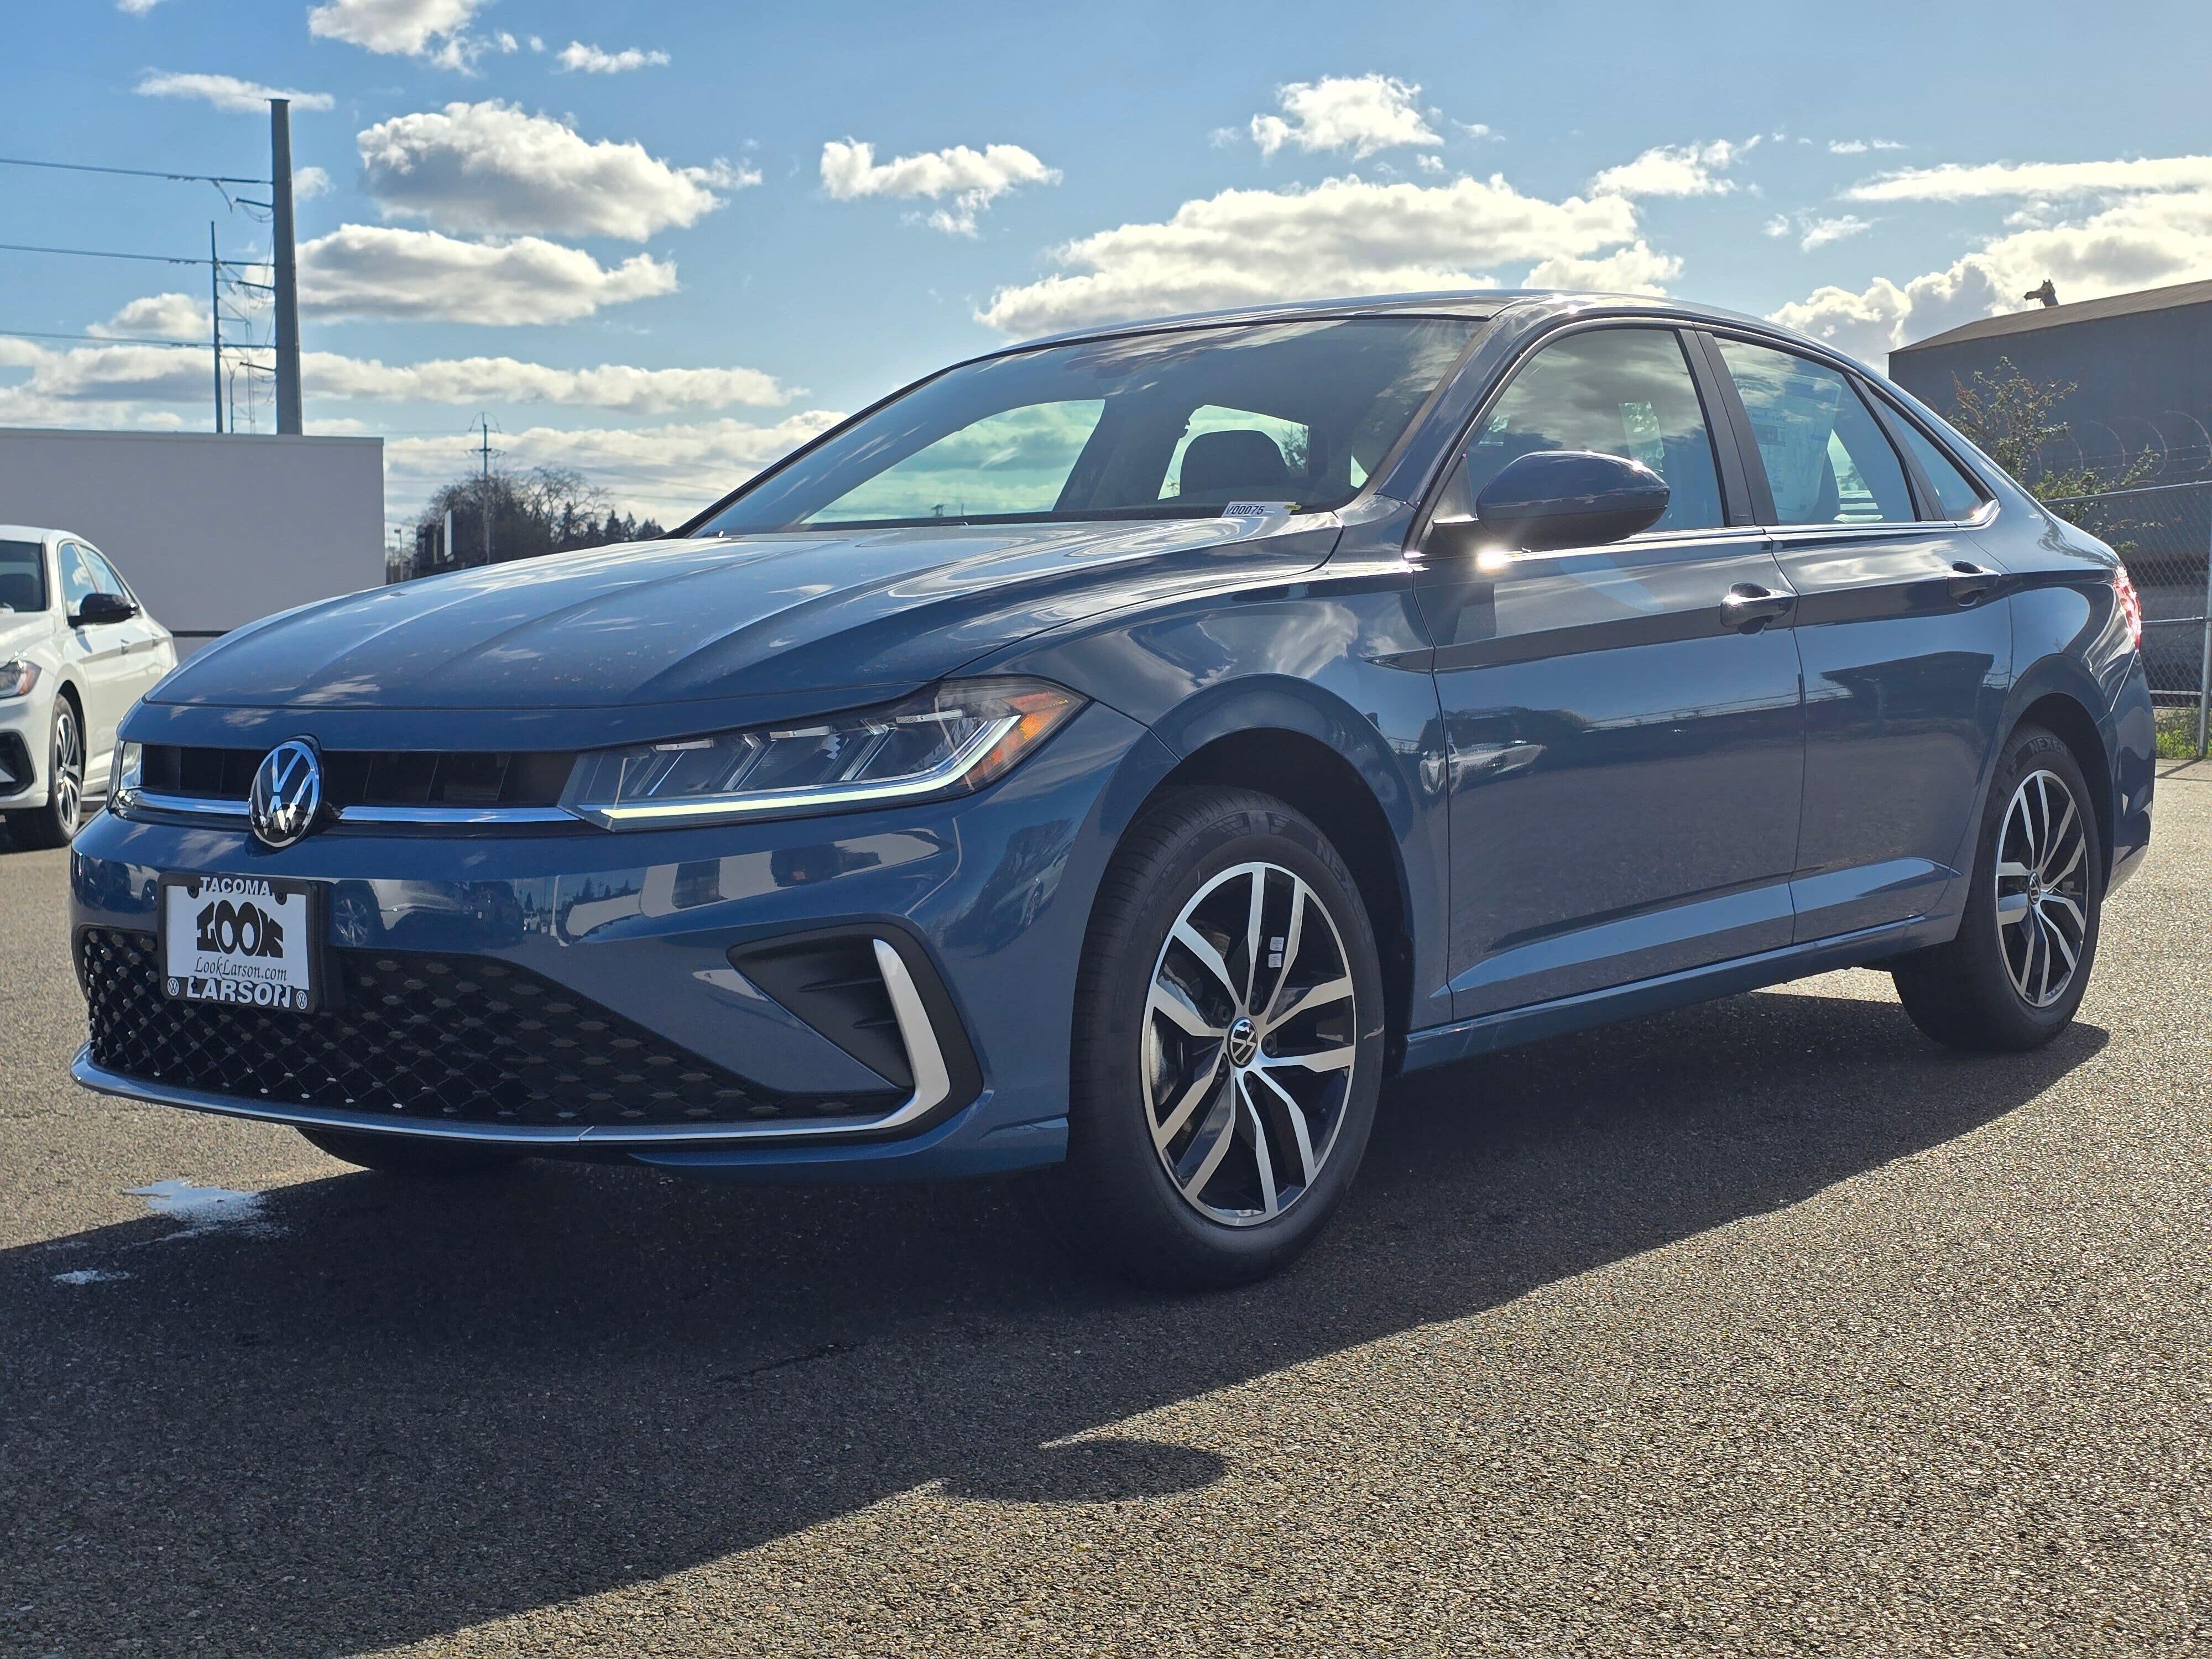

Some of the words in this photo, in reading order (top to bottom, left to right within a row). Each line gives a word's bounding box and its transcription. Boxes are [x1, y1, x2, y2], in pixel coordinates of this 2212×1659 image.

[250, 740, 319, 847] VW
[200, 877, 272, 896] TACOMA
[197, 900, 283, 958] LOOK
[194, 956, 287, 981] LookLarson.com
[186, 976, 291, 1008] LARSON
